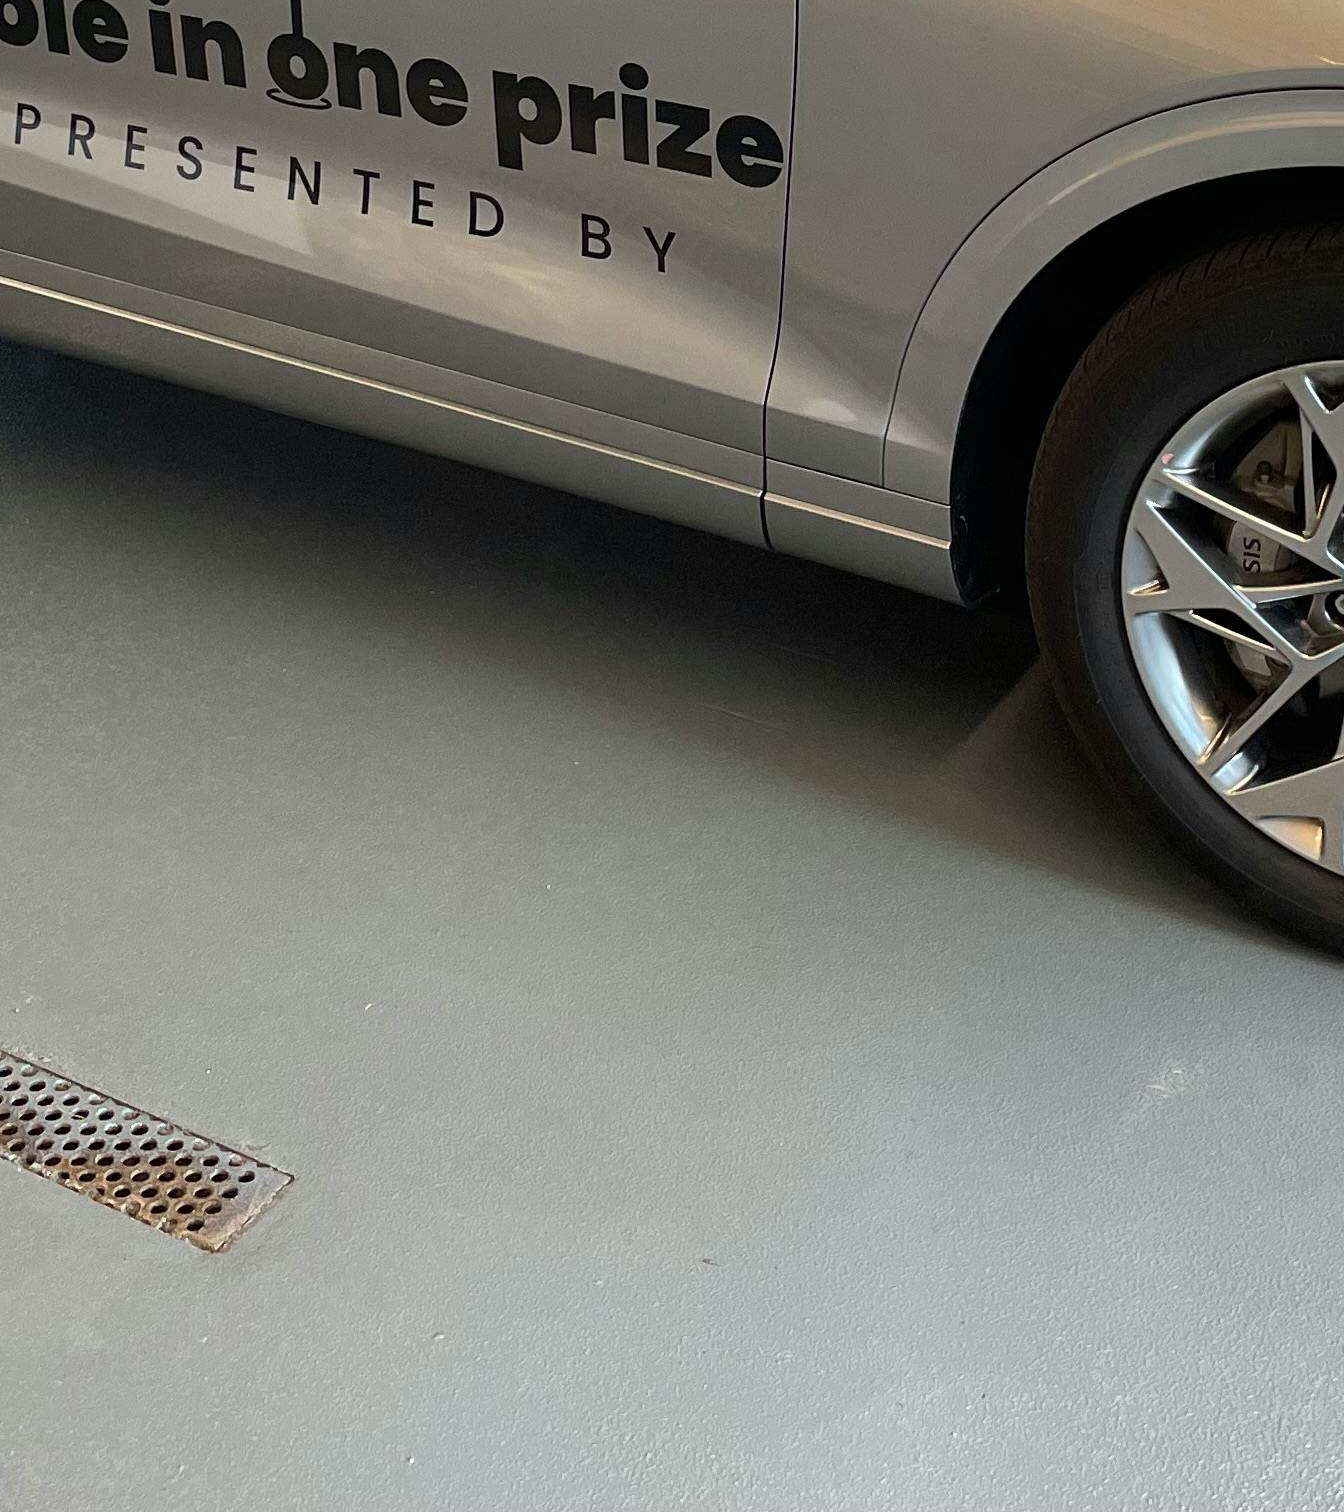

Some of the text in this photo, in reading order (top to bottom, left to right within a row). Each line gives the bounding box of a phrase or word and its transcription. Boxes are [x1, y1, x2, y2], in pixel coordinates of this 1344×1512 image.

[14, 101, 677, 273] PRESENTED BY
[266, 31, 468, 127] one
[492, 62, 785, 189] prize
